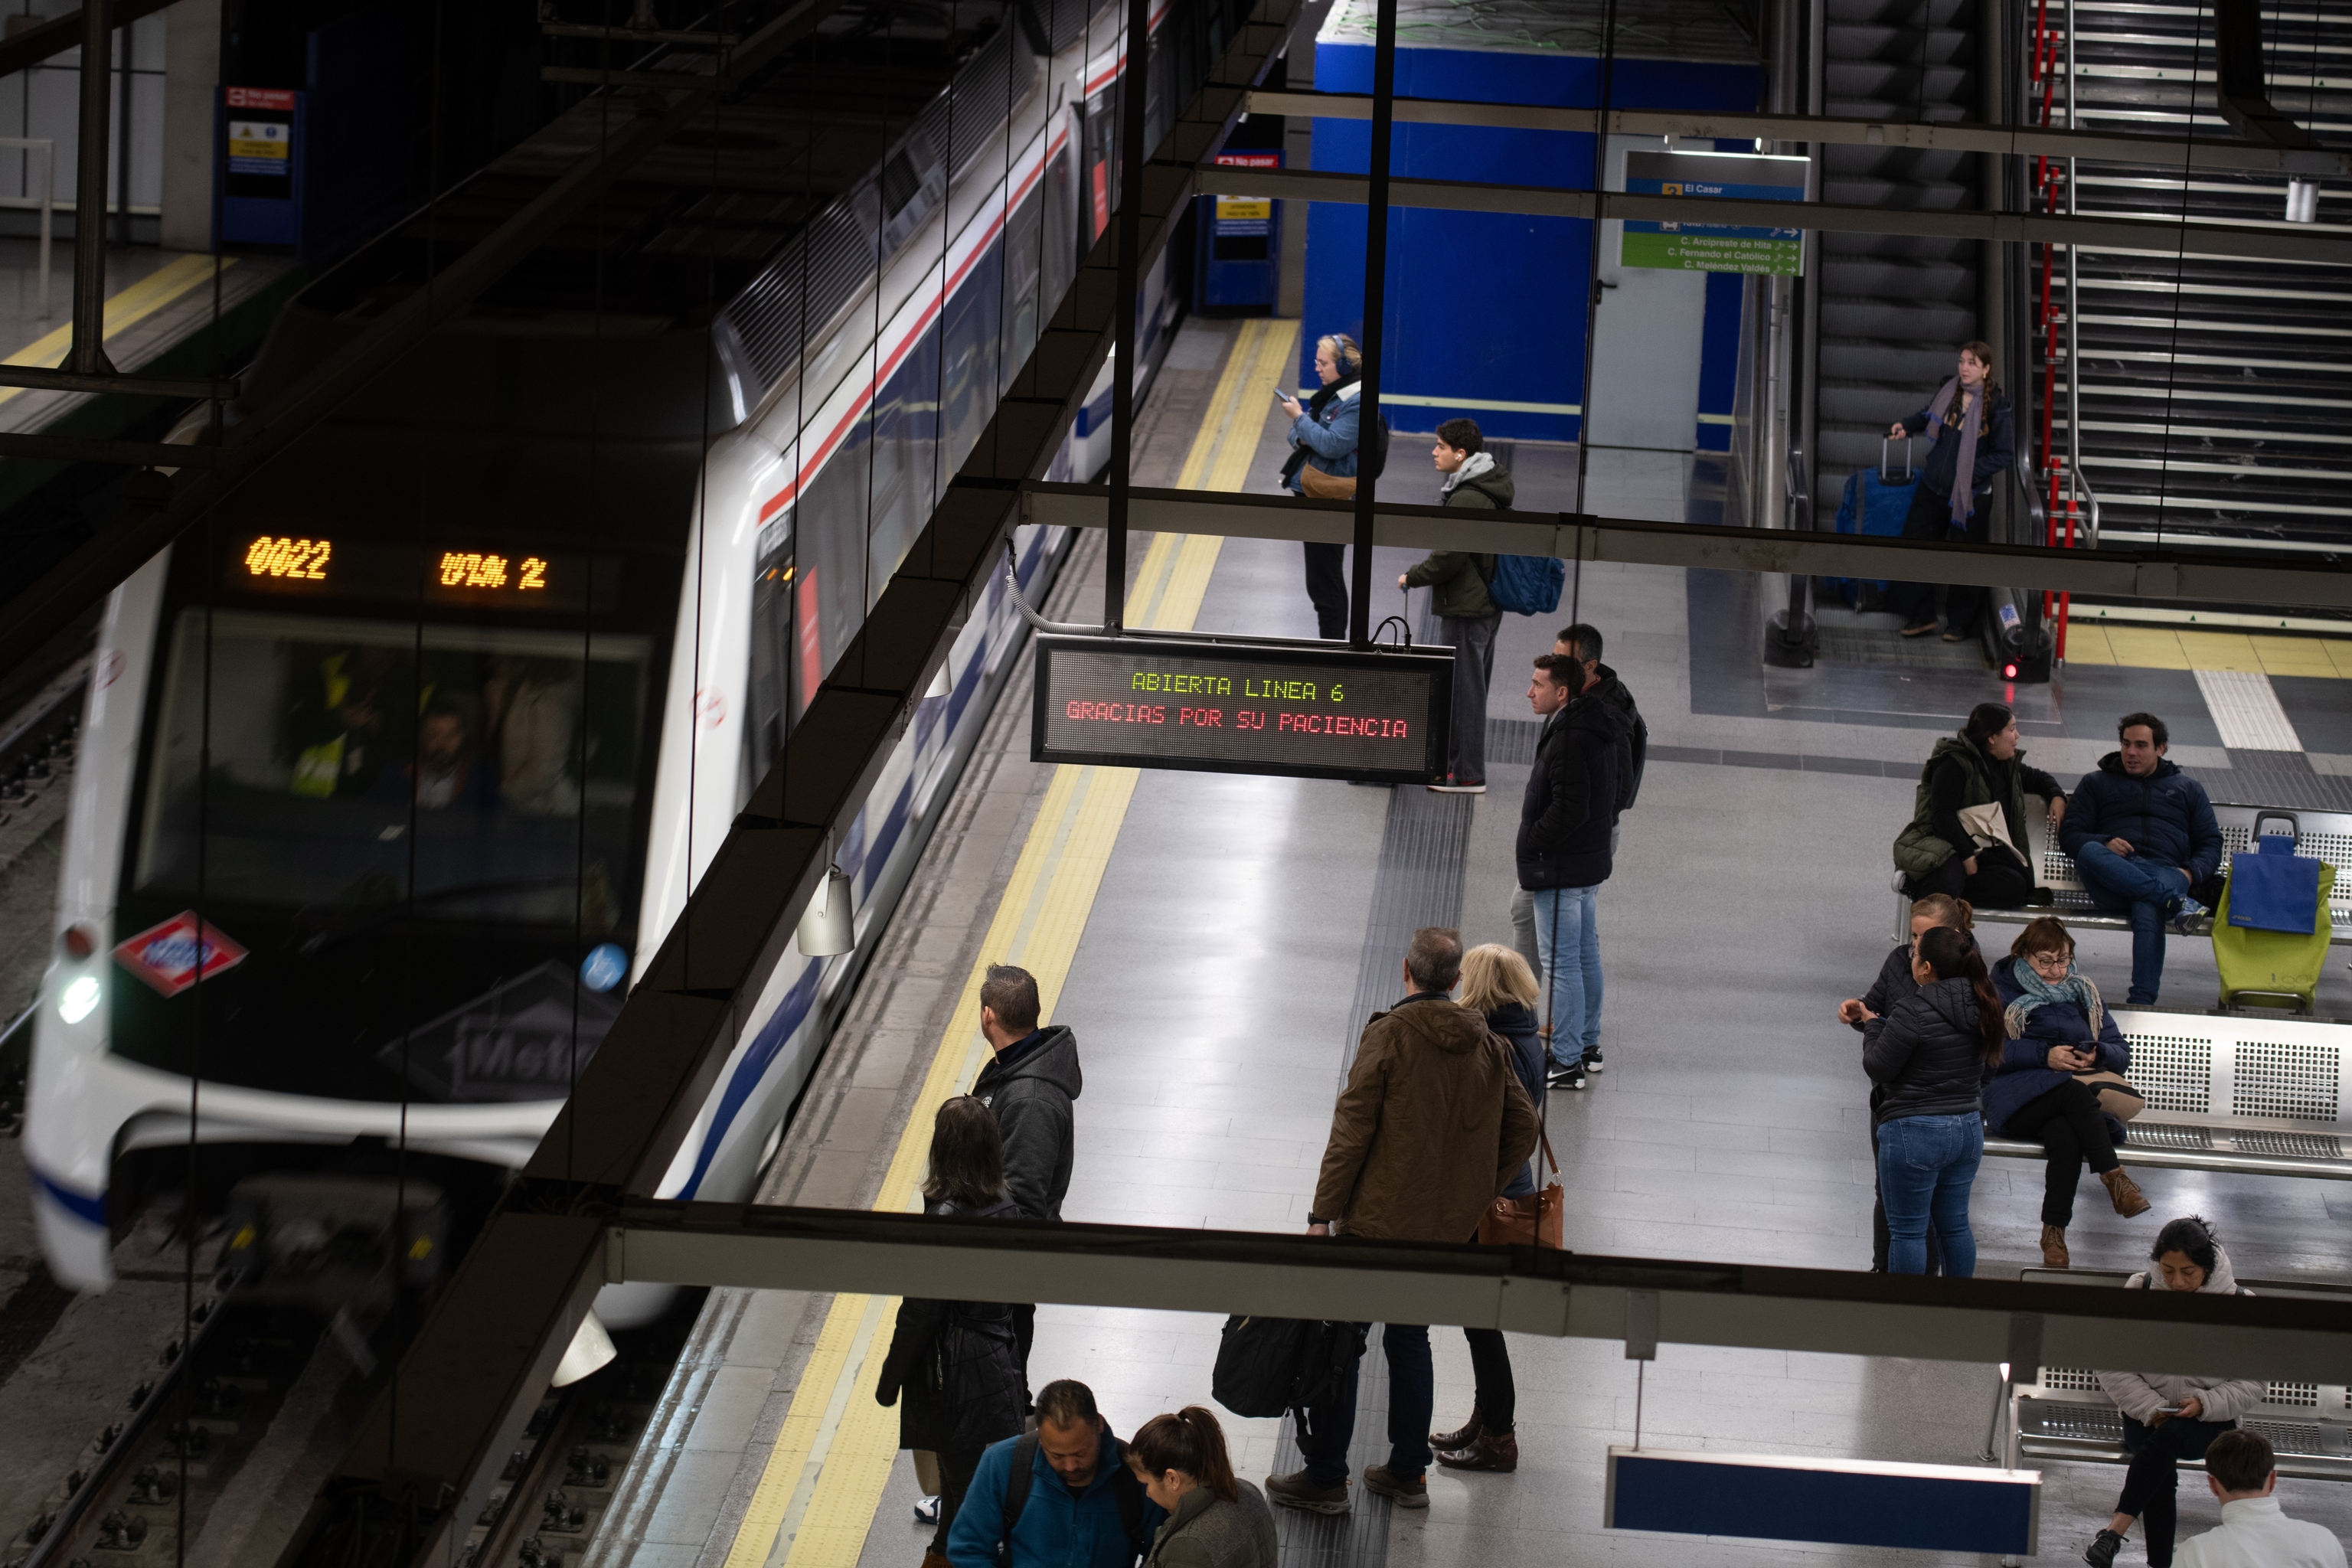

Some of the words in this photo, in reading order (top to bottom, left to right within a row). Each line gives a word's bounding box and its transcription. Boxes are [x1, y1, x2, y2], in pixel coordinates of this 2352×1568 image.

[1235, 157, 1248, 166] No
[1250, 158, 1274, 168] pasar
[1696, 185, 1723, 194] Casar
[1681, 237, 1690, 245] C.
[1693, 237, 1738, 248] Arcipreste
[1754, 241, 1772, 250] Hita
[1668, 247, 1677, 256] C.
[1680, 248, 1721, 259] Fernando
[1734, 251, 1771, 261] Católico
[1697, 261, 1739, 271] Meléndez
[1741, 263, 1770, 273] Valdés
[519, 558, 547, 589] 2
[1132, 672, 1231, 695] ABIERTA
[1246, 679, 1316, 701] LINEA
[1331, 684, 1344, 701] 6
[1067, 701, 1165, 724] GRACIAS
[1180, 707, 1222, 727] POR
[1237, 710, 1266, 729] SU
[1279, 714, 1407, 738] PACIENCIA
